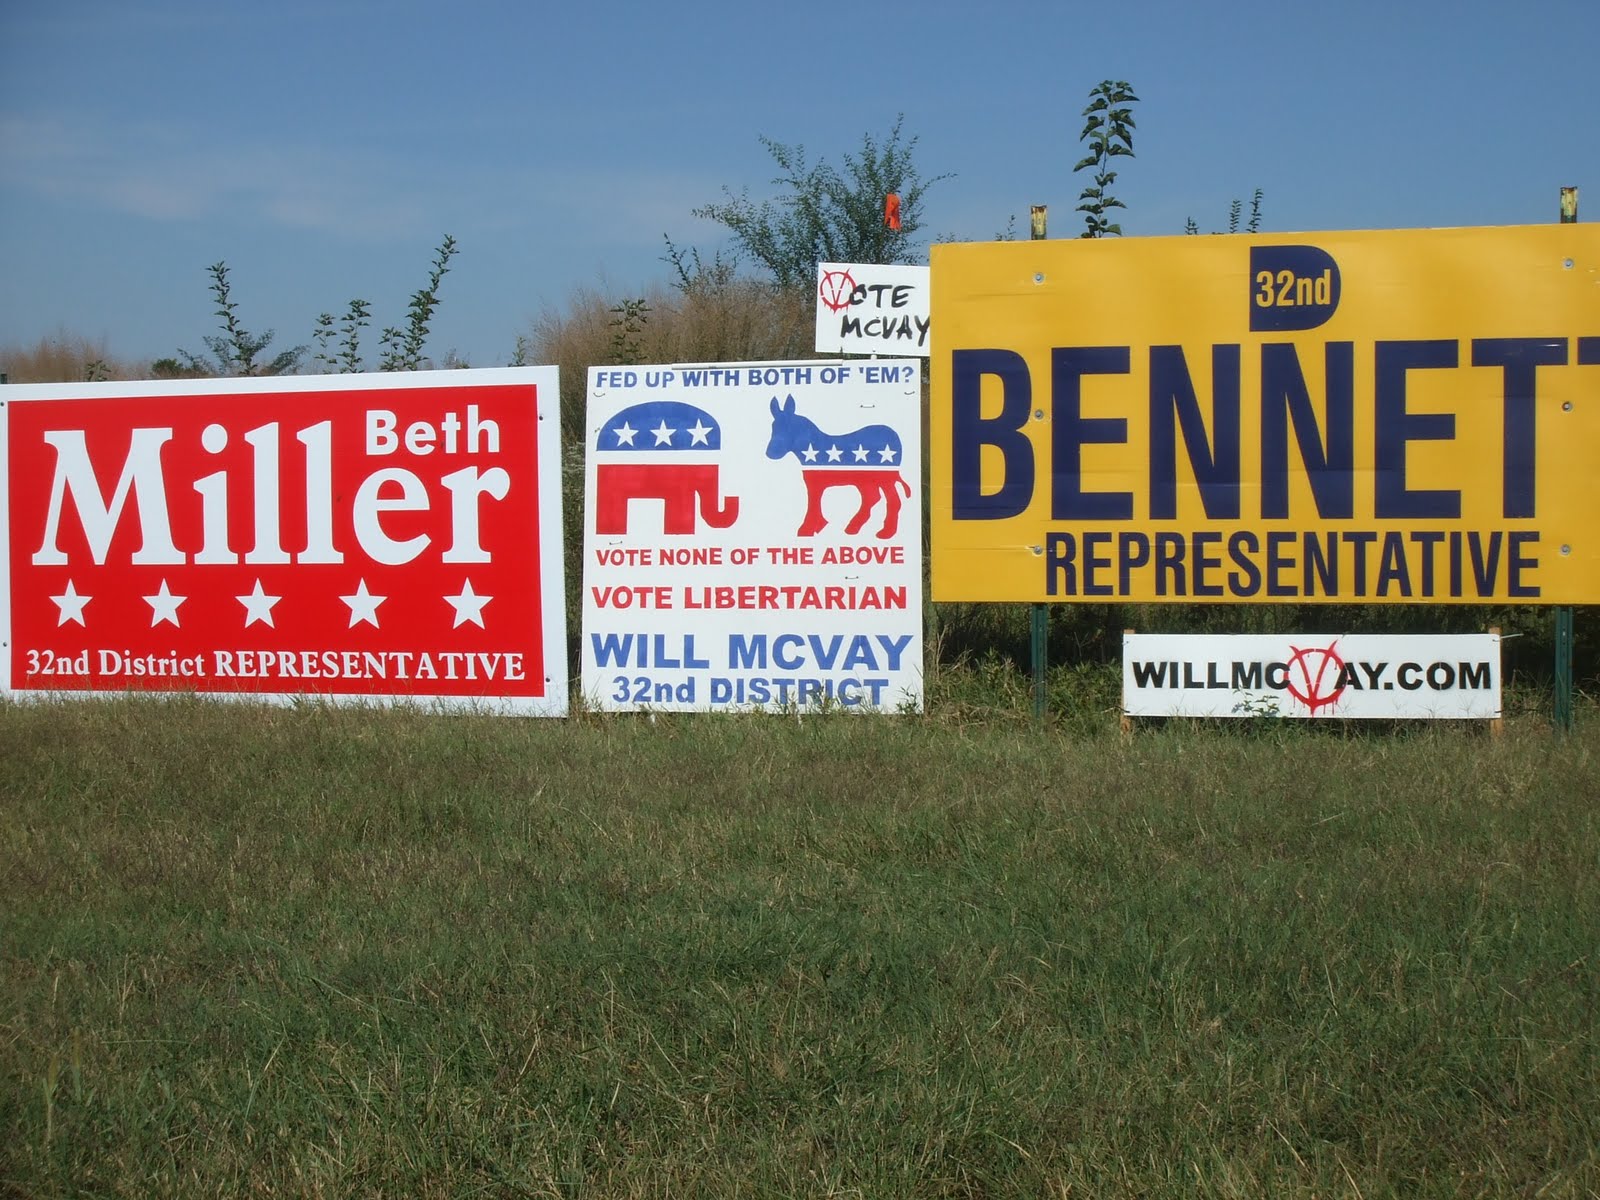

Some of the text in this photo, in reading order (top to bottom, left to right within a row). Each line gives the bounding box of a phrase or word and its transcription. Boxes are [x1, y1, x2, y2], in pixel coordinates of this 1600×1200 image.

[820, 268, 916, 314] VOTE
[1256, 269, 1332, 307] 32nd
[840, 314, 930, 347] MCVAY
[596, 366, 914, 388] FED UP WITH BOTH OF 'EM?
[365, 404, 499, 455] Beth
[952, 337, 1600, 521] BENNET
[31, 420, 511, 566] Miller
[596, 546, 905, 567] VOTE NONE OF THE ABOVE
[1045, 531, 1541, 597] REPRESENTATIVE
[591, 585, 907, 610] VOTE LIBERTARIAN
[26, 649, 526, 681] 32nd District REPRESENTATIVE
[591, 633, 914, 671] WILL MCVAY
[612, 676, 890, 706] 32nd DISTRICT
[1132, 640, 1492, 715] WILLMCVAY.COM
